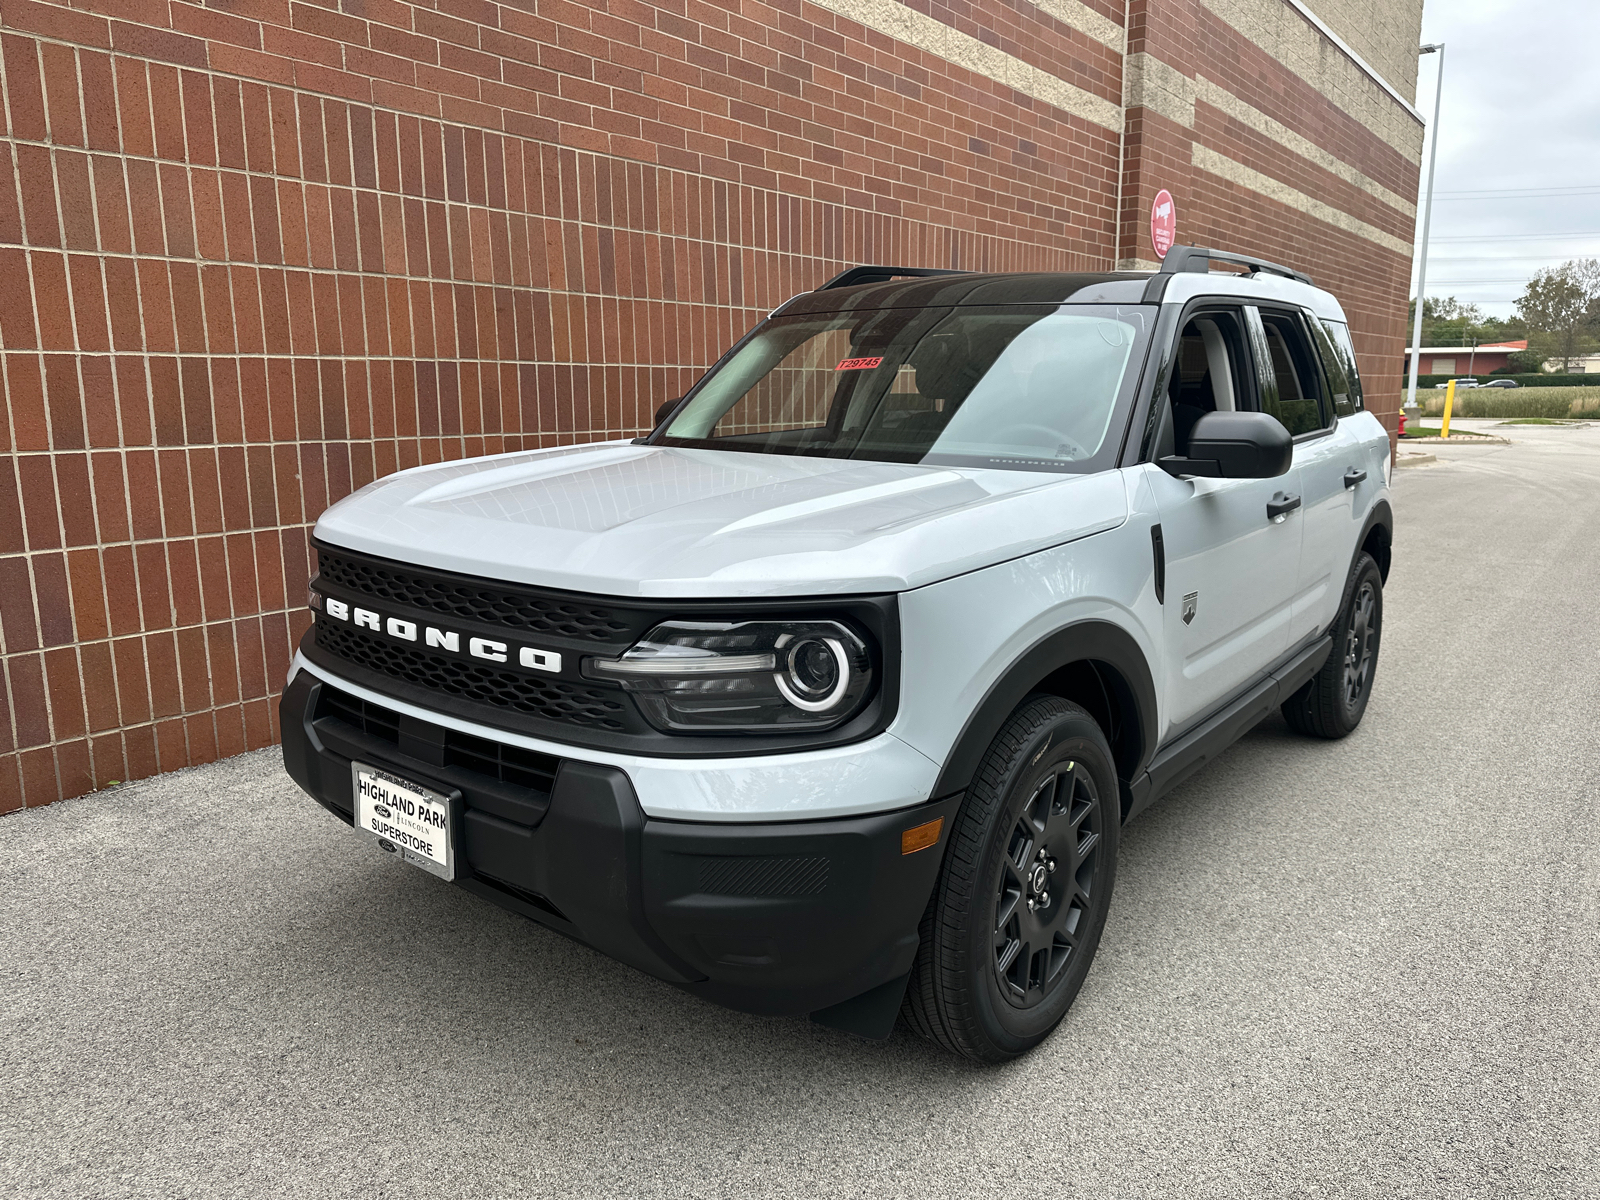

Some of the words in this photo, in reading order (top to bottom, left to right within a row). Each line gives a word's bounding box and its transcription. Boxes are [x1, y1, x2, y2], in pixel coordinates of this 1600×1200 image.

[839, 358, 880, 368] T29745
[326, 598, 561, 673] BRONCO
[360, 780, 415, 816] HIGHLAND
[418, 805, 446, 830] PARK
[371, 818, 433, 857] SUPERSTORE
[401, 817, 430, 835] LINCOLN
